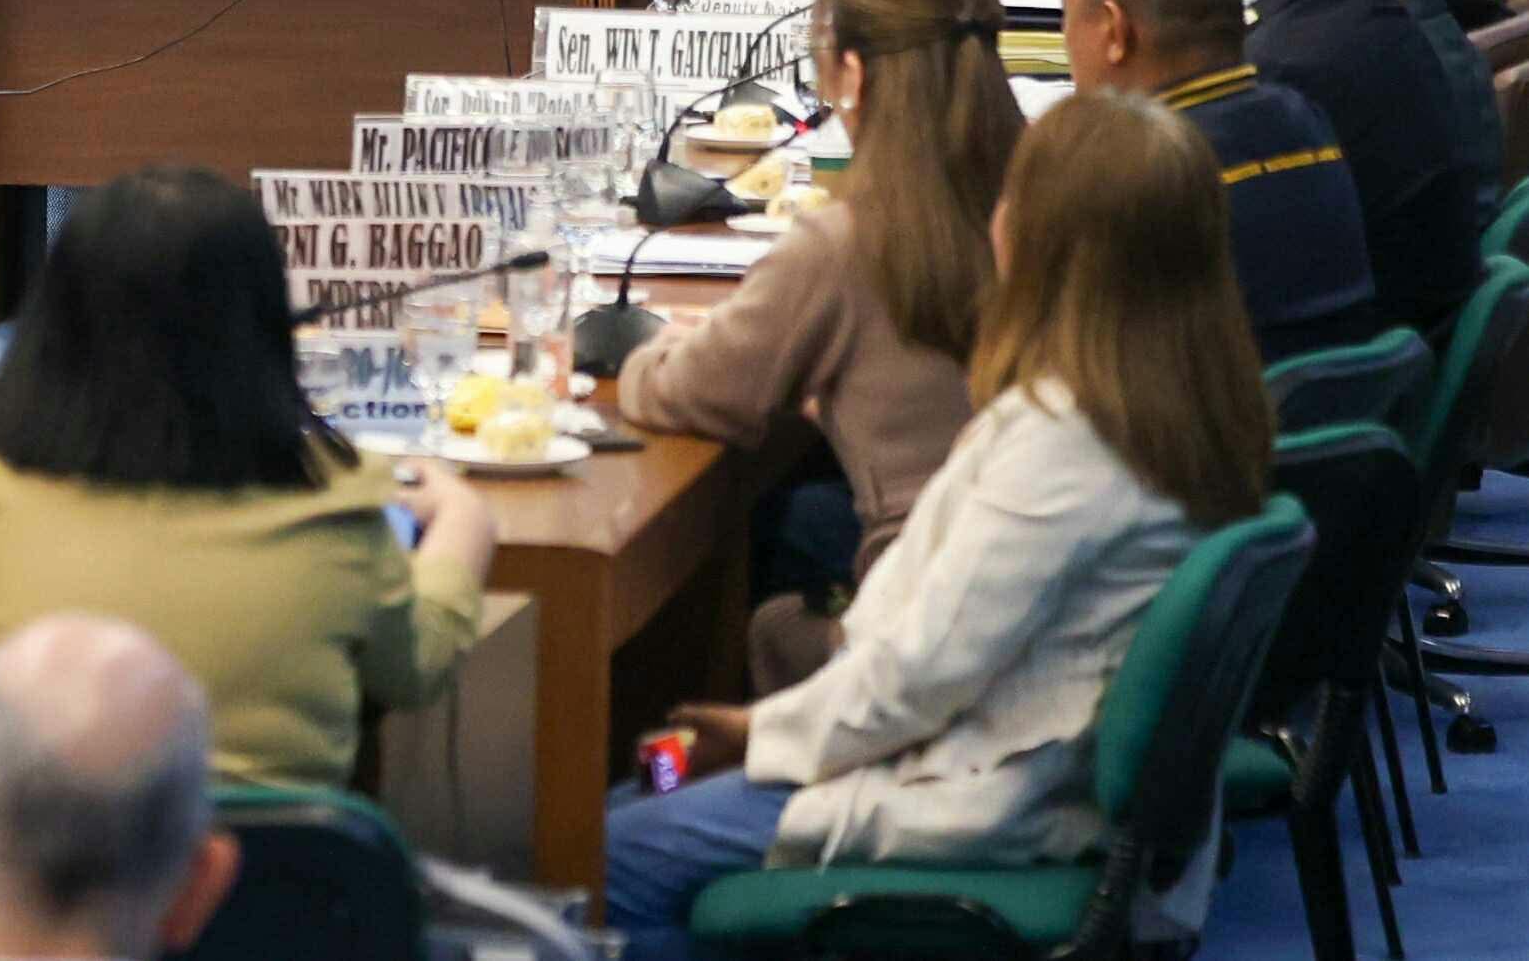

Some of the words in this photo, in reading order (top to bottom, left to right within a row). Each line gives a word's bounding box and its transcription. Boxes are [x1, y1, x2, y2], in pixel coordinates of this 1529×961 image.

[557, 25, 595, 75] Sen.
[605, 28, 642, 71] WIN
[649, 29, 661, 77] T.
[361, 127, 391, 173] Mr.
[401, 127, 495, 174] PACIFICO
[331, 224, 357, 269] G.
[369, 223, 483, 270] BAGGAO
